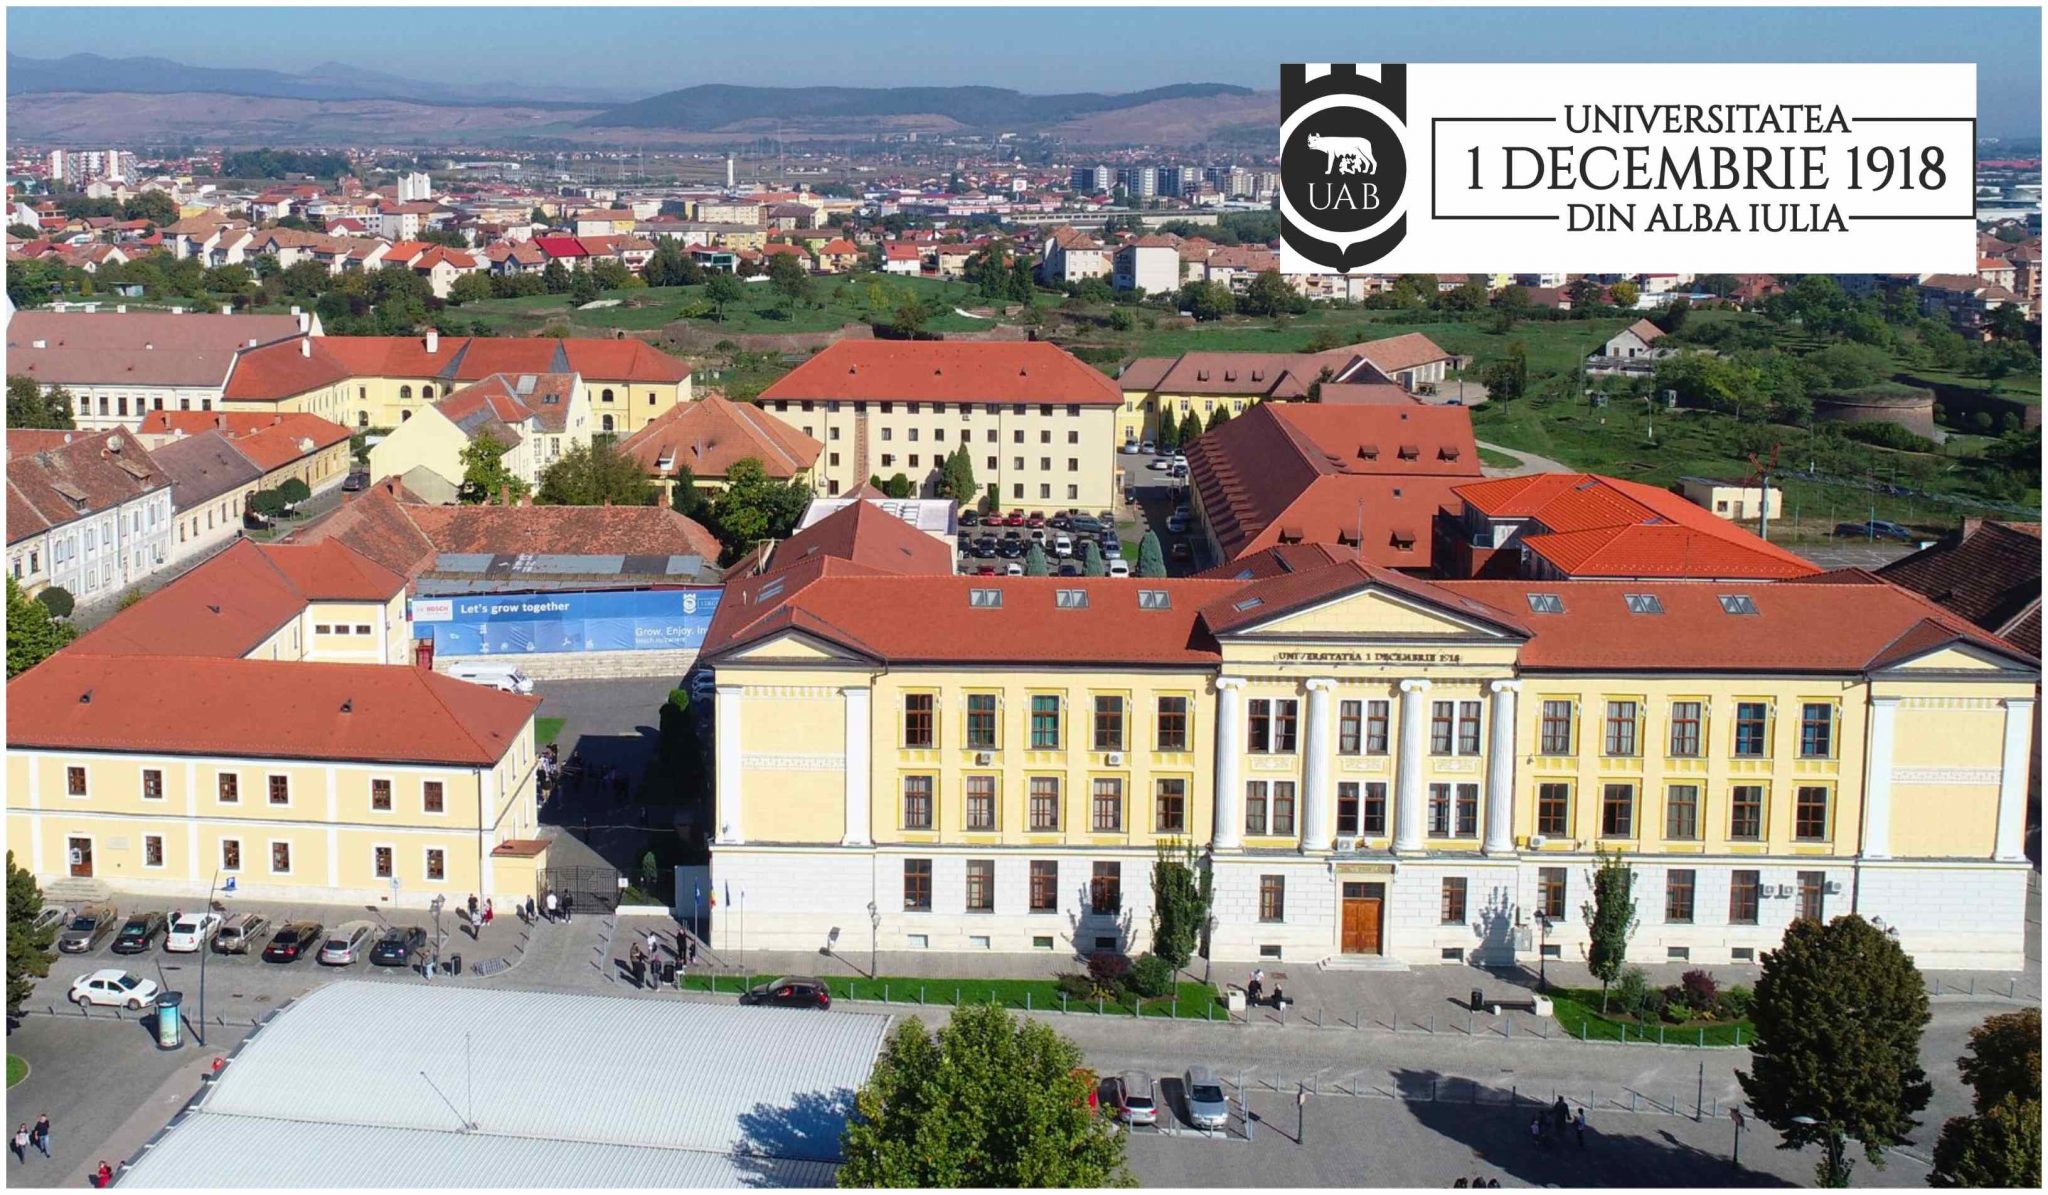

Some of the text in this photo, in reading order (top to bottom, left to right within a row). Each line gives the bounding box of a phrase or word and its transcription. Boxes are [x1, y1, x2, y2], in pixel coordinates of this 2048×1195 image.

[460, 601, 570, 615] Let's grow together
[635, 627, 664, 636] Grow.
[666, 626, 694, 637] Enjoy.
[1278, 652, 1362, 661] UNIVERSITATEA
[1365, 653, 1371, 661] 1
[1375, 653, 1436, 662] DECEMBRIE
